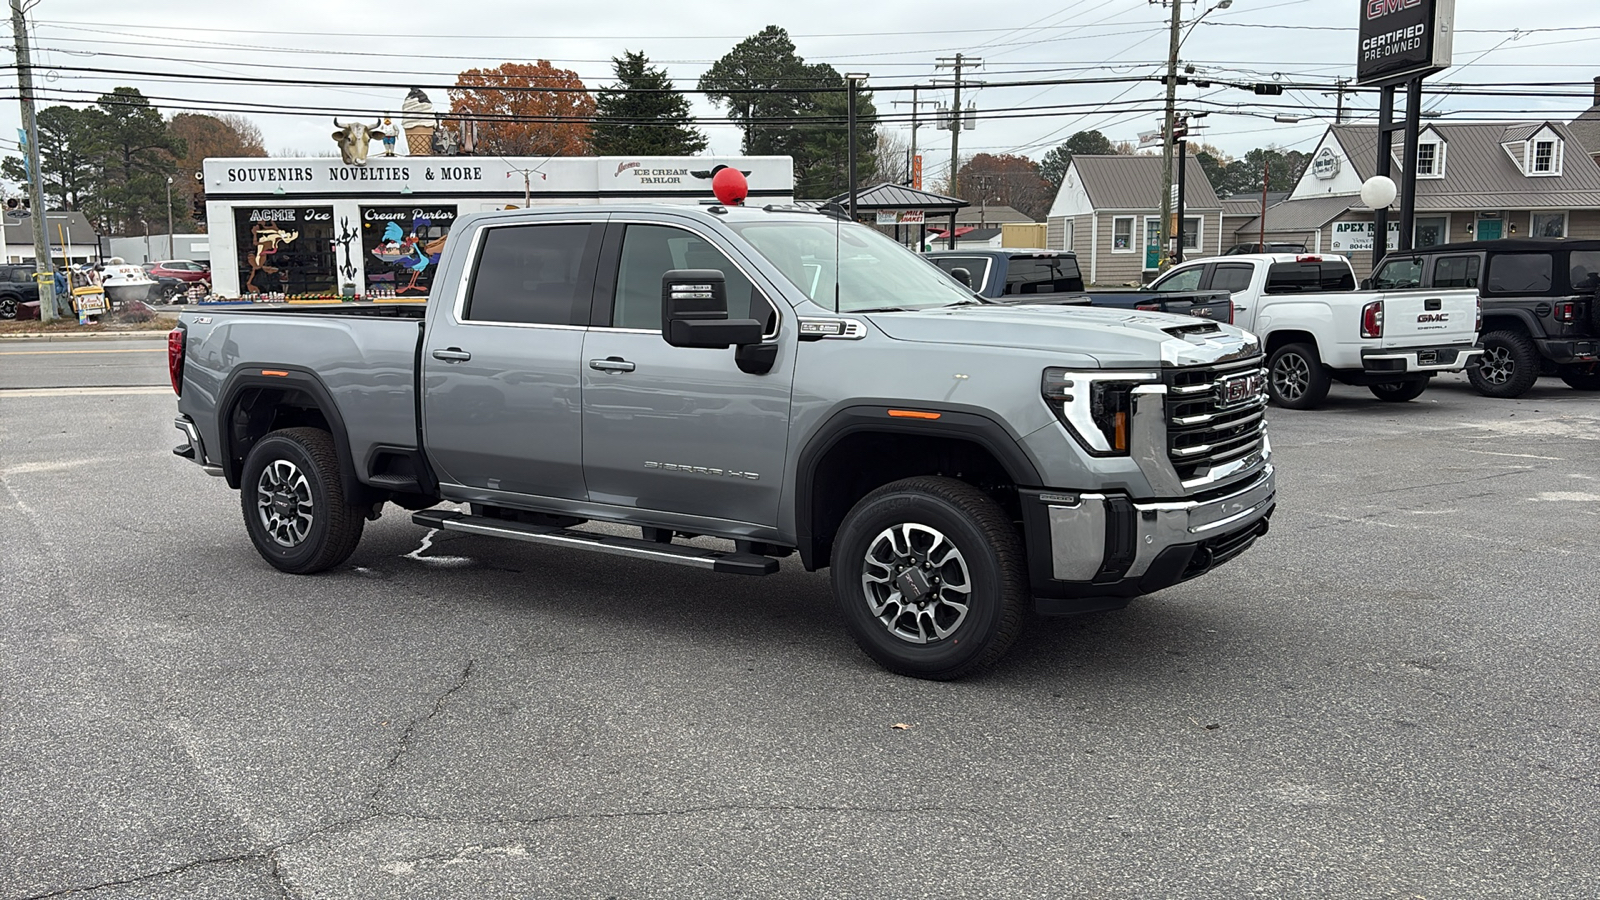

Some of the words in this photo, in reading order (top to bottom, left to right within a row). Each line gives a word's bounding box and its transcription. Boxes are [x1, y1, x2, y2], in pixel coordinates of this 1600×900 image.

[1362, 23, 1425, 51] CERTIFIED
[1364, 38, 1421, 62] PRE-OWNED
[228, 167, 313, 182] SOUVENIRS
[329, 167, 410, 181] NOVELTIES
[425, 167, 435, 181] &
[441, 167, 482, 180] MORE
[652, 168, 688, 176] CREAM
[249, 209, 296, 221] ACME
[303, 209, 331, 221] Ice
[364, 209, 406, 221] Cream
[412, 209, 454, 221] Parlor
[1336, 223, 1364, 232] APEX
[1417, 313, 1449, 323] GMC
[1226, 375, 1262, 402] GMC
[644, 460, 724, 476] SIERRA
[728, 469, 760, 480] HD
